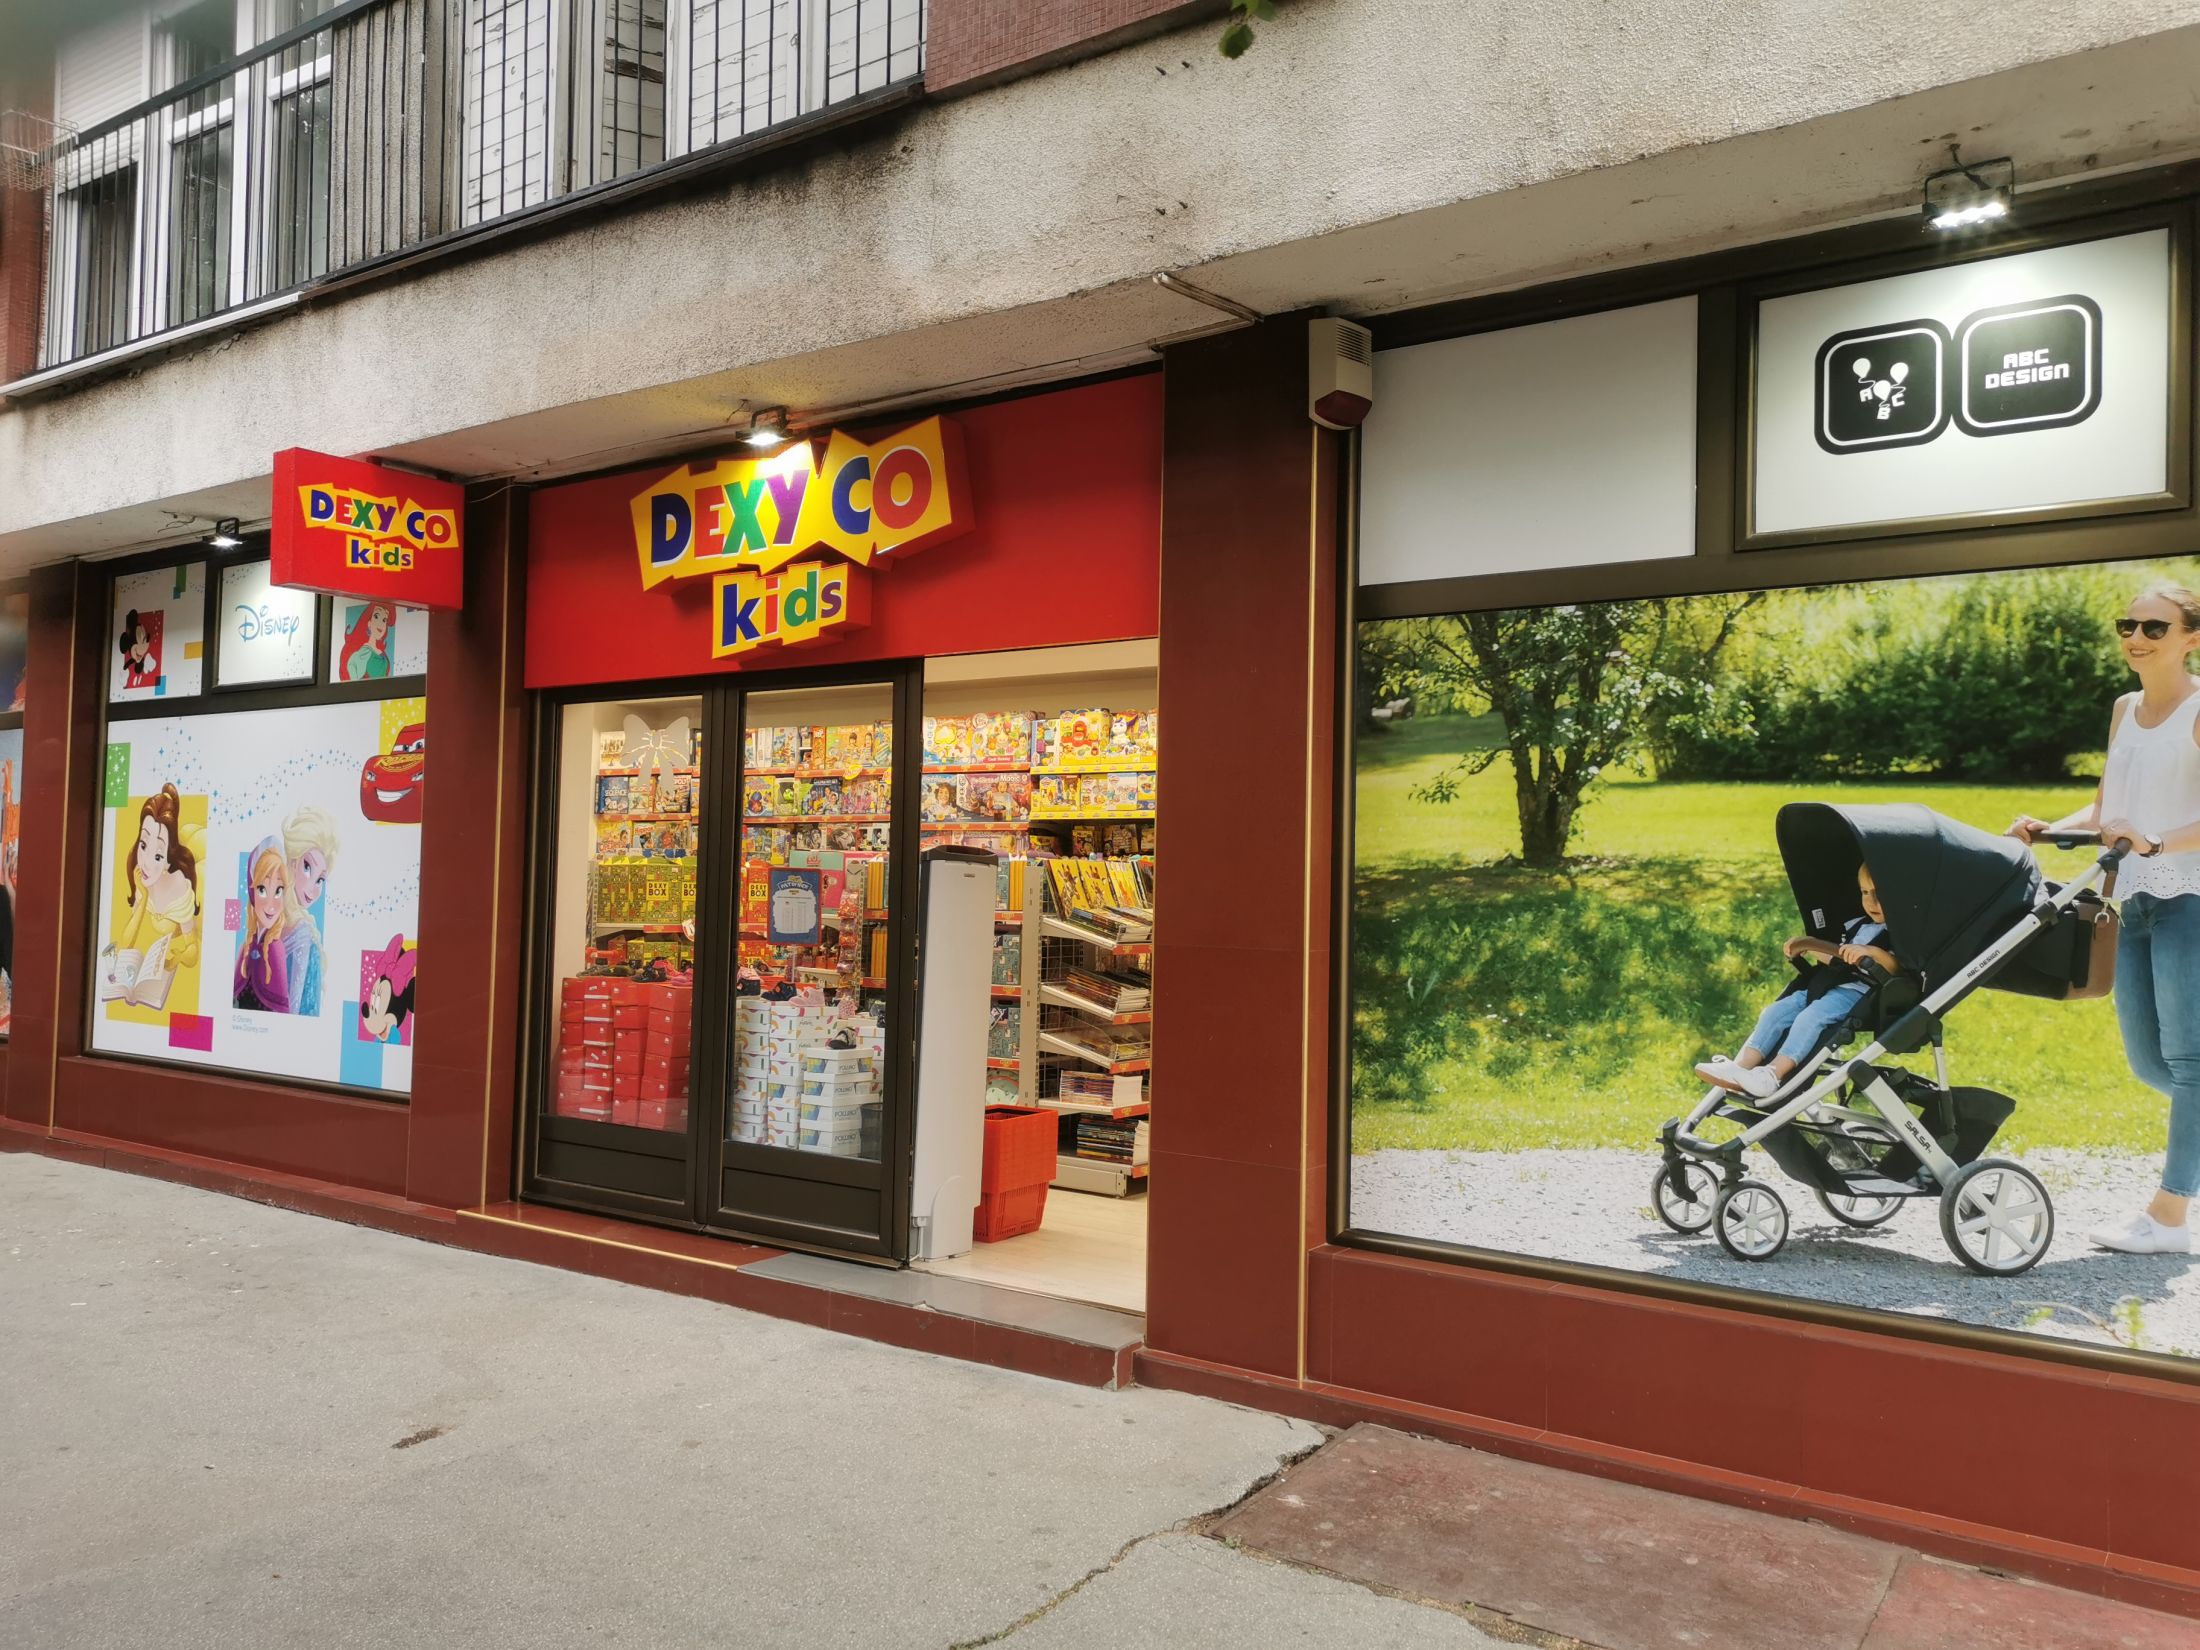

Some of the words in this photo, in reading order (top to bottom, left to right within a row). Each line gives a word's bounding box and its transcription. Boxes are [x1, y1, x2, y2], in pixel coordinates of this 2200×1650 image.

[2002, 348, 2050, 370] ABC
[1984, 362, 2071, 389] DESIGN
[310, 489, 396, 534] DEXY
[406, 510, 452, 544] CO
[650, 469, 809, 568] DEXY
[832, 445, 933, 535] CO
[350, 539, 412, 567] kids
[722, 569, 842, 648] kids
[648, 888, 667, 896] BOX
[750, 889, 767, 897] BOX
[1904, 1120, 1931, 1151] SALSA
